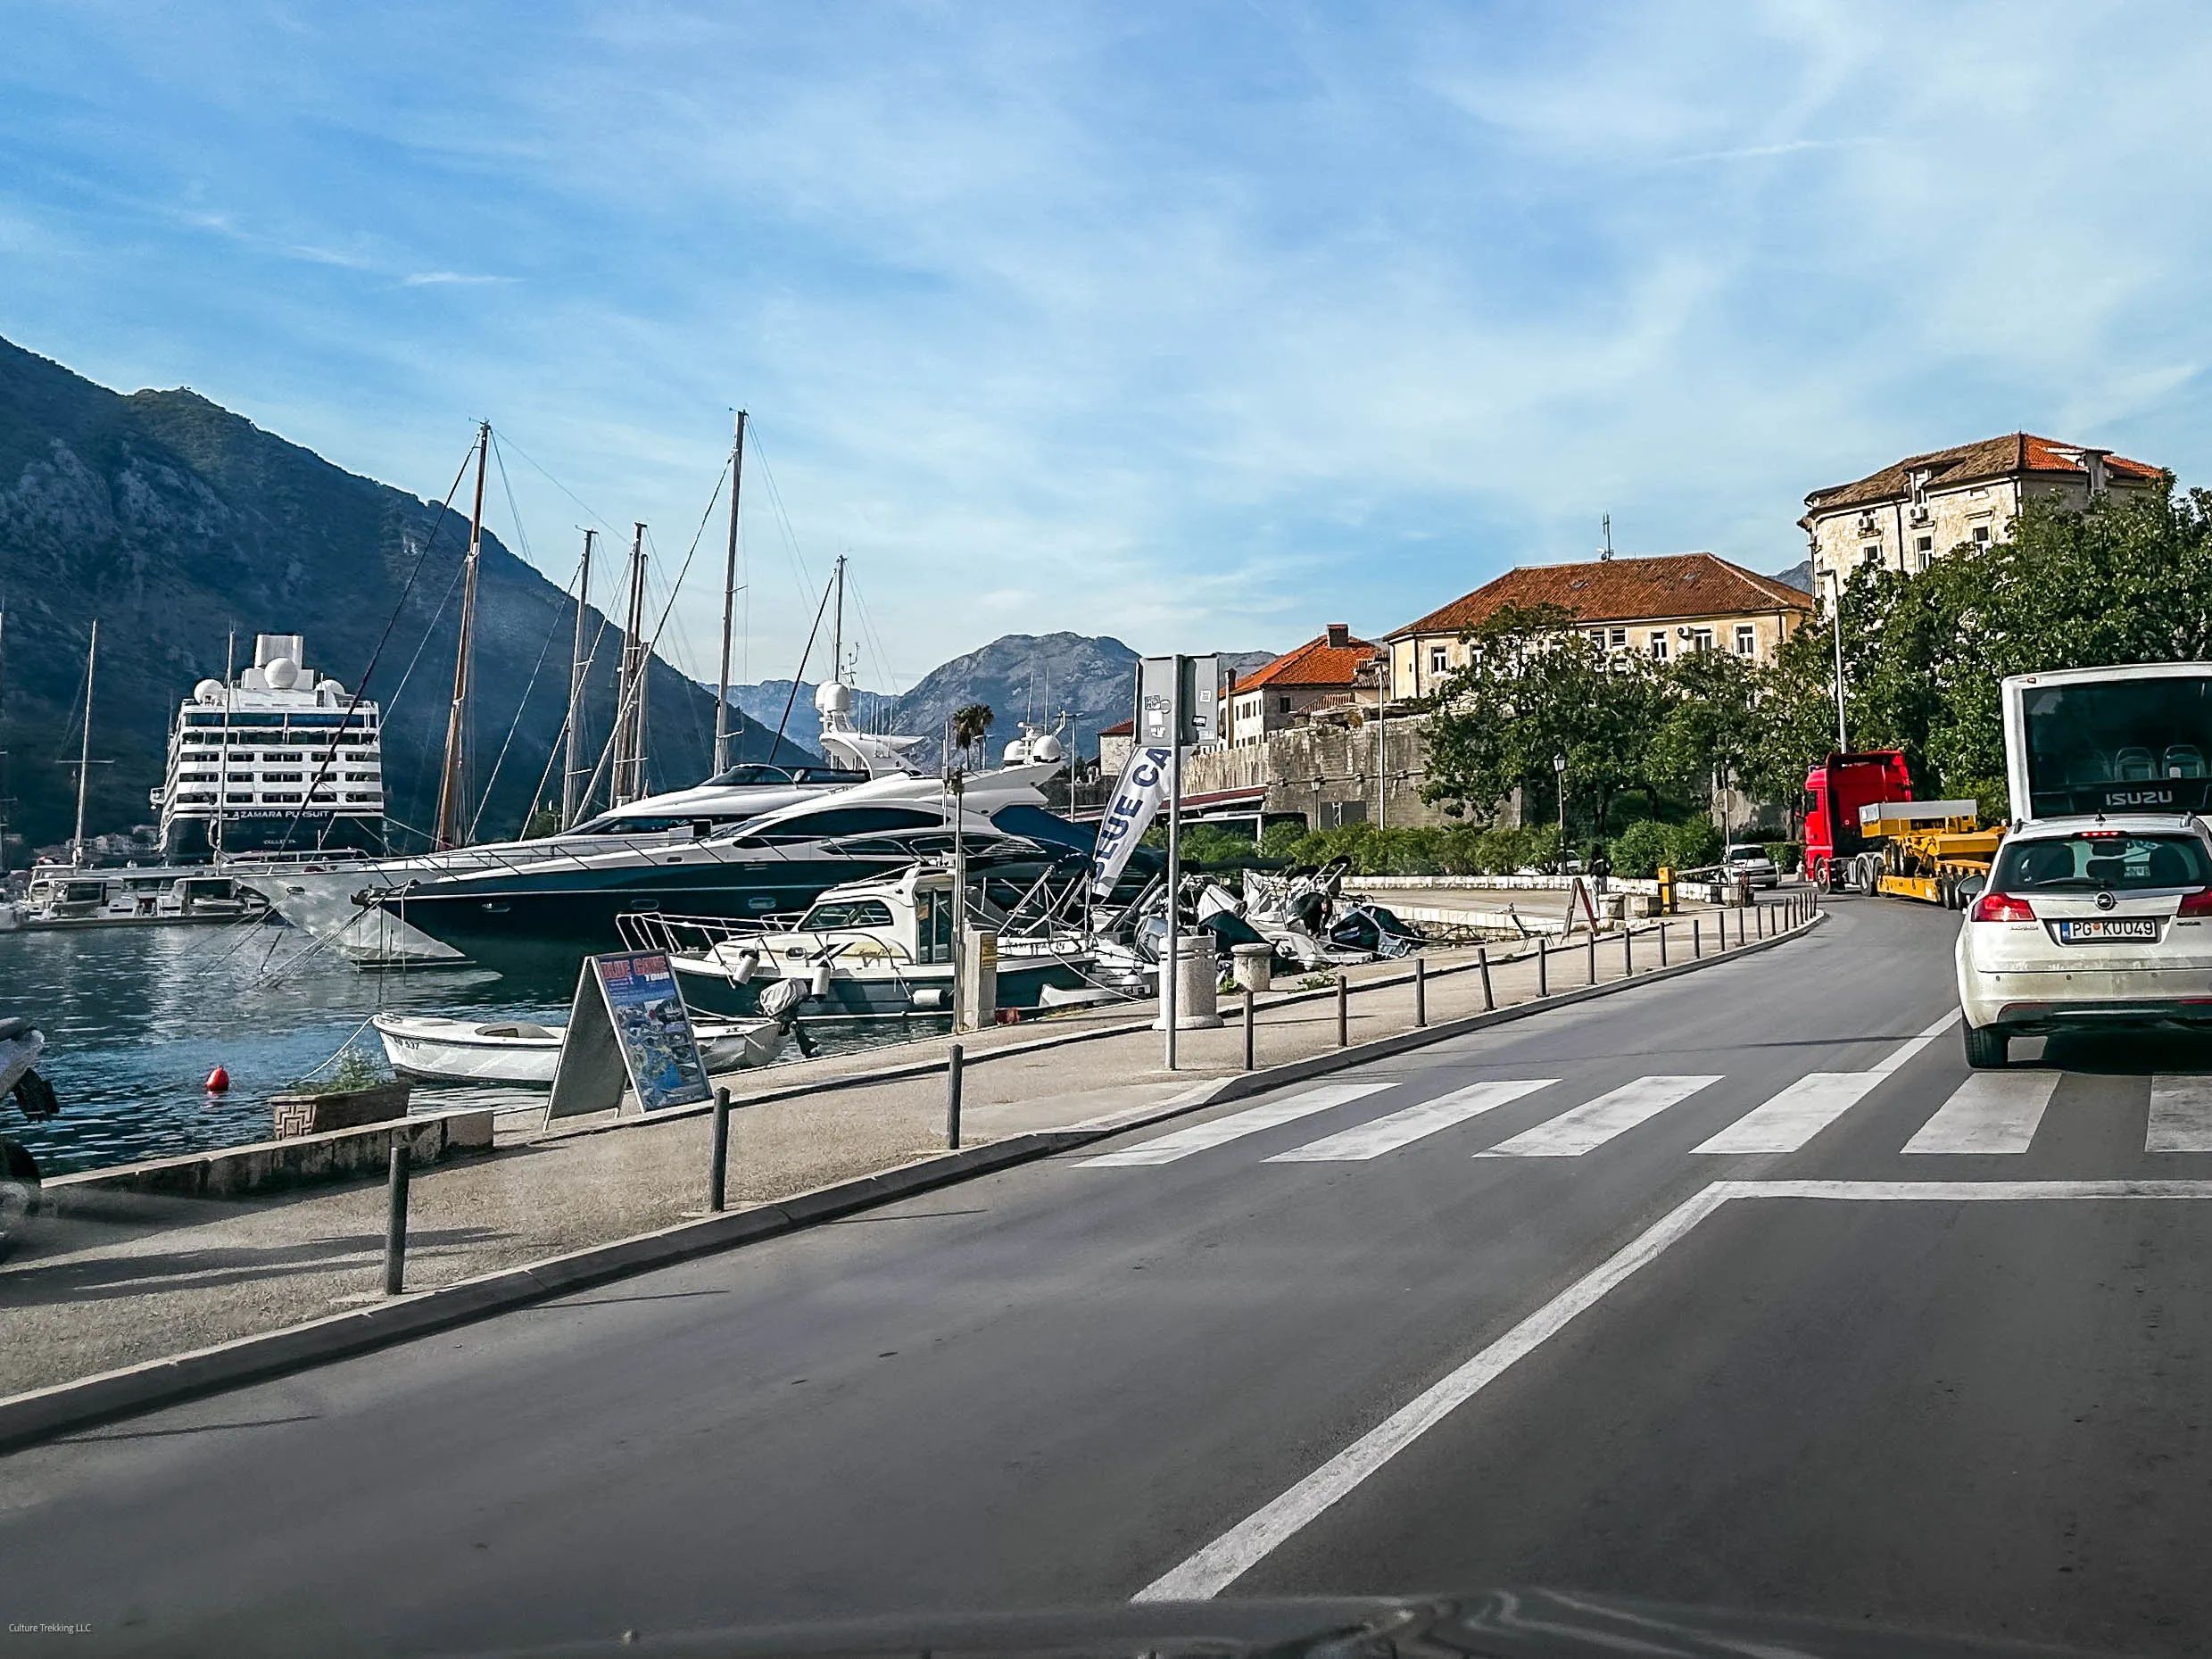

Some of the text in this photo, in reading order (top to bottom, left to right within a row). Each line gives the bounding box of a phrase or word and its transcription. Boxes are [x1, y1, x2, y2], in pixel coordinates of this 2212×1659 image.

[2105, 790, 2174, 807] ISUZU
[232, 810, 329, 818] AZAMARA PURSUIT
[2073, 922, 2092, 937] PG
[600, 957, 667, 978] BLUE CAVE
[644, 972, 670, 983] TOUR
